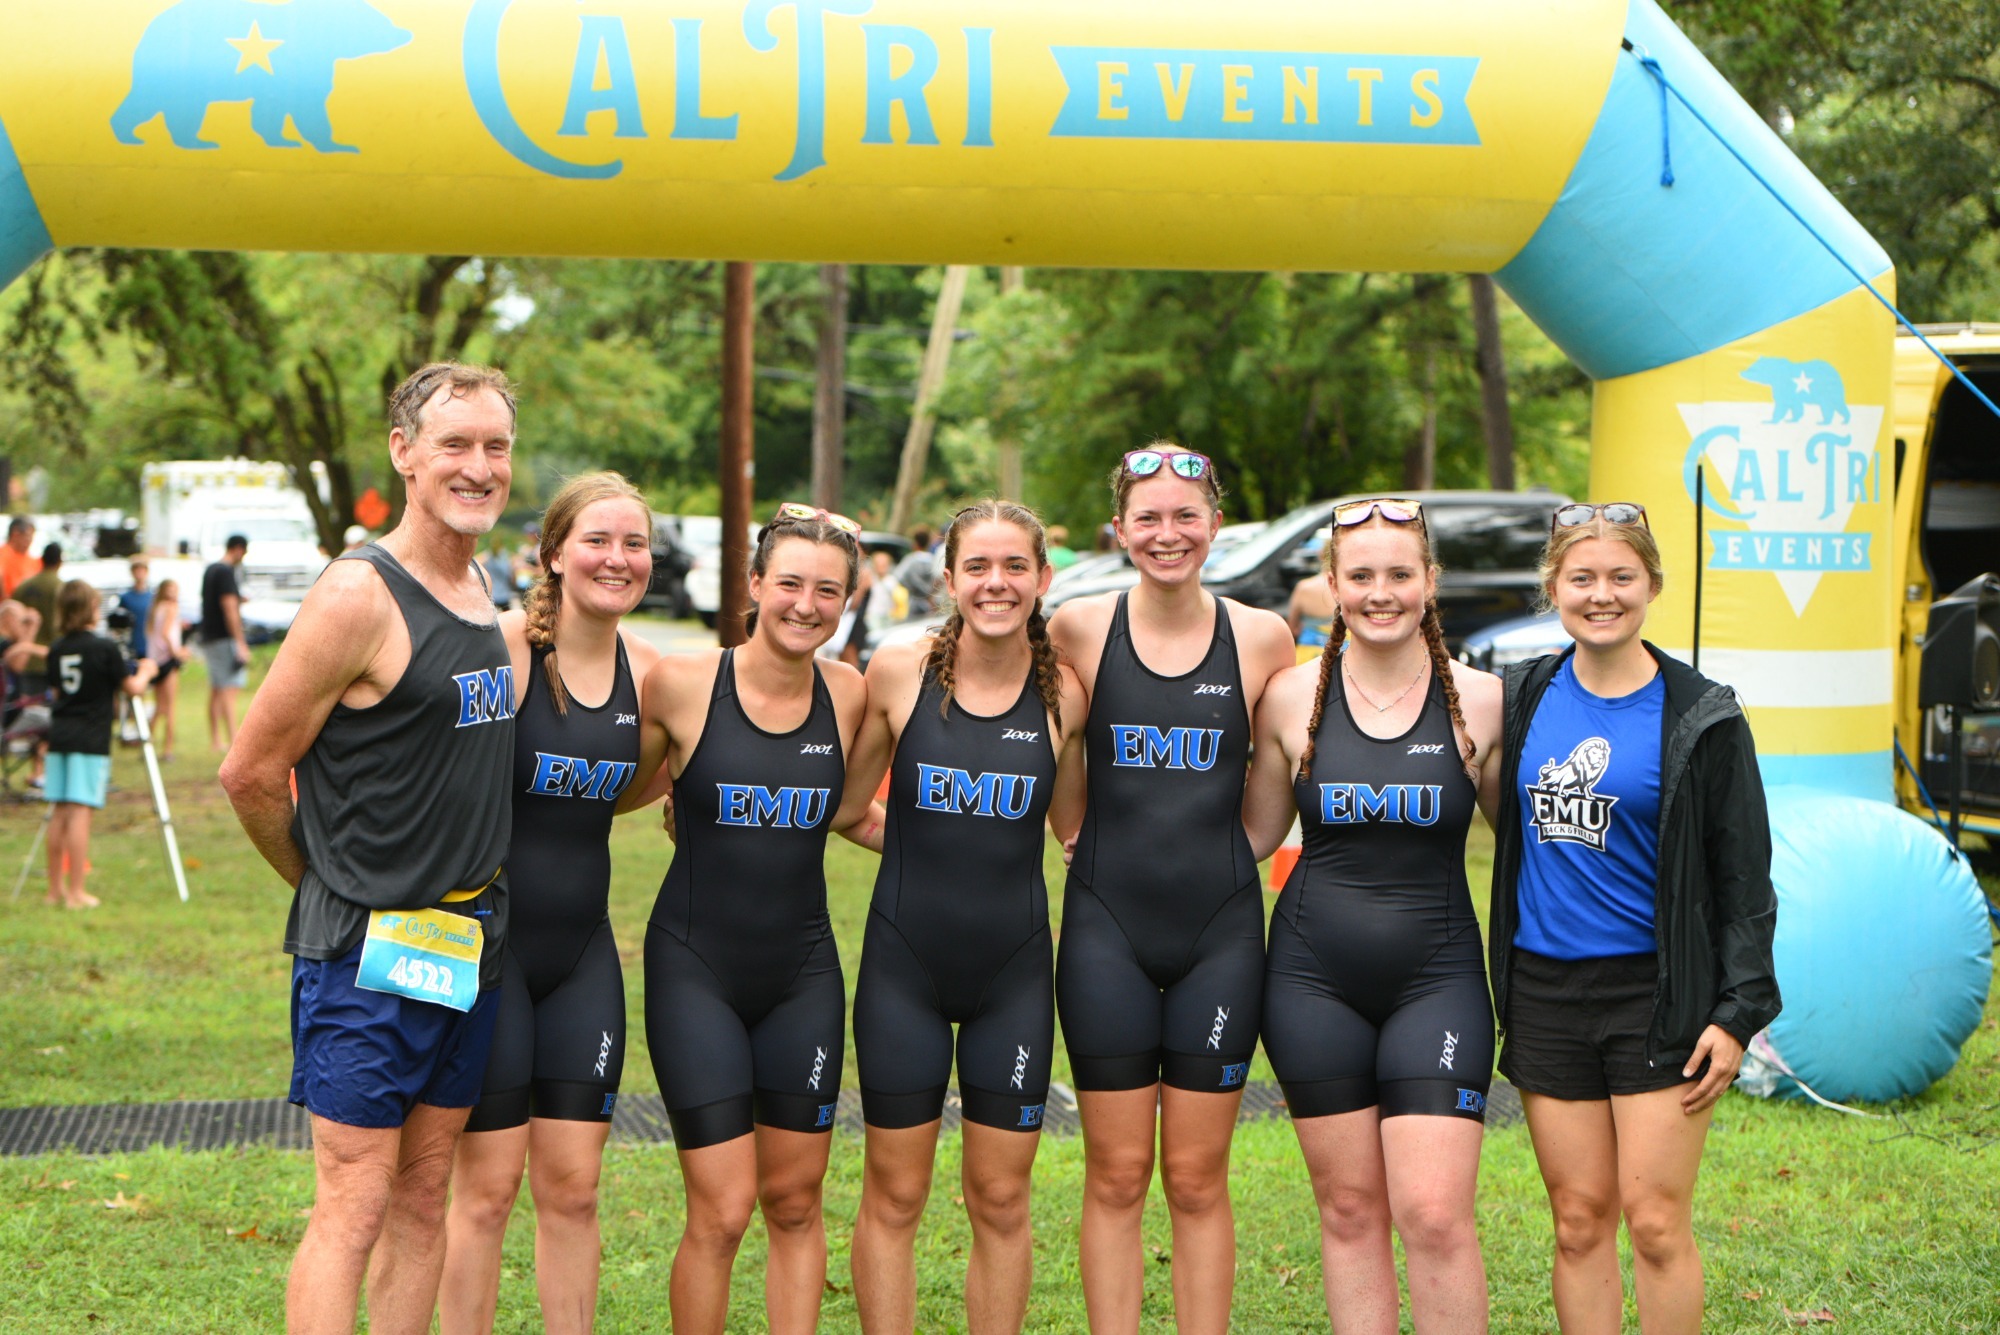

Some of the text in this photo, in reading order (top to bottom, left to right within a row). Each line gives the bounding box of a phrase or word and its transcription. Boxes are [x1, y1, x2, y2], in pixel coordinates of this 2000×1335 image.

[1096, 60, 1443, 128] EVENTS
[1727, 535, 1863, 565] EVENTS
[60, 654, 82, 694] 5
[1110, 724, 1224, 771] EMU
[526, 752, 637, 801] EMU
[916, 763, 1037, 819] EMU
[715, 783, 831, 829] EMU
[1319, 783, 1443, 826] EMU
[1533, 792, 1606, 831] EMU
[386, 955, 454, 997] 4522
